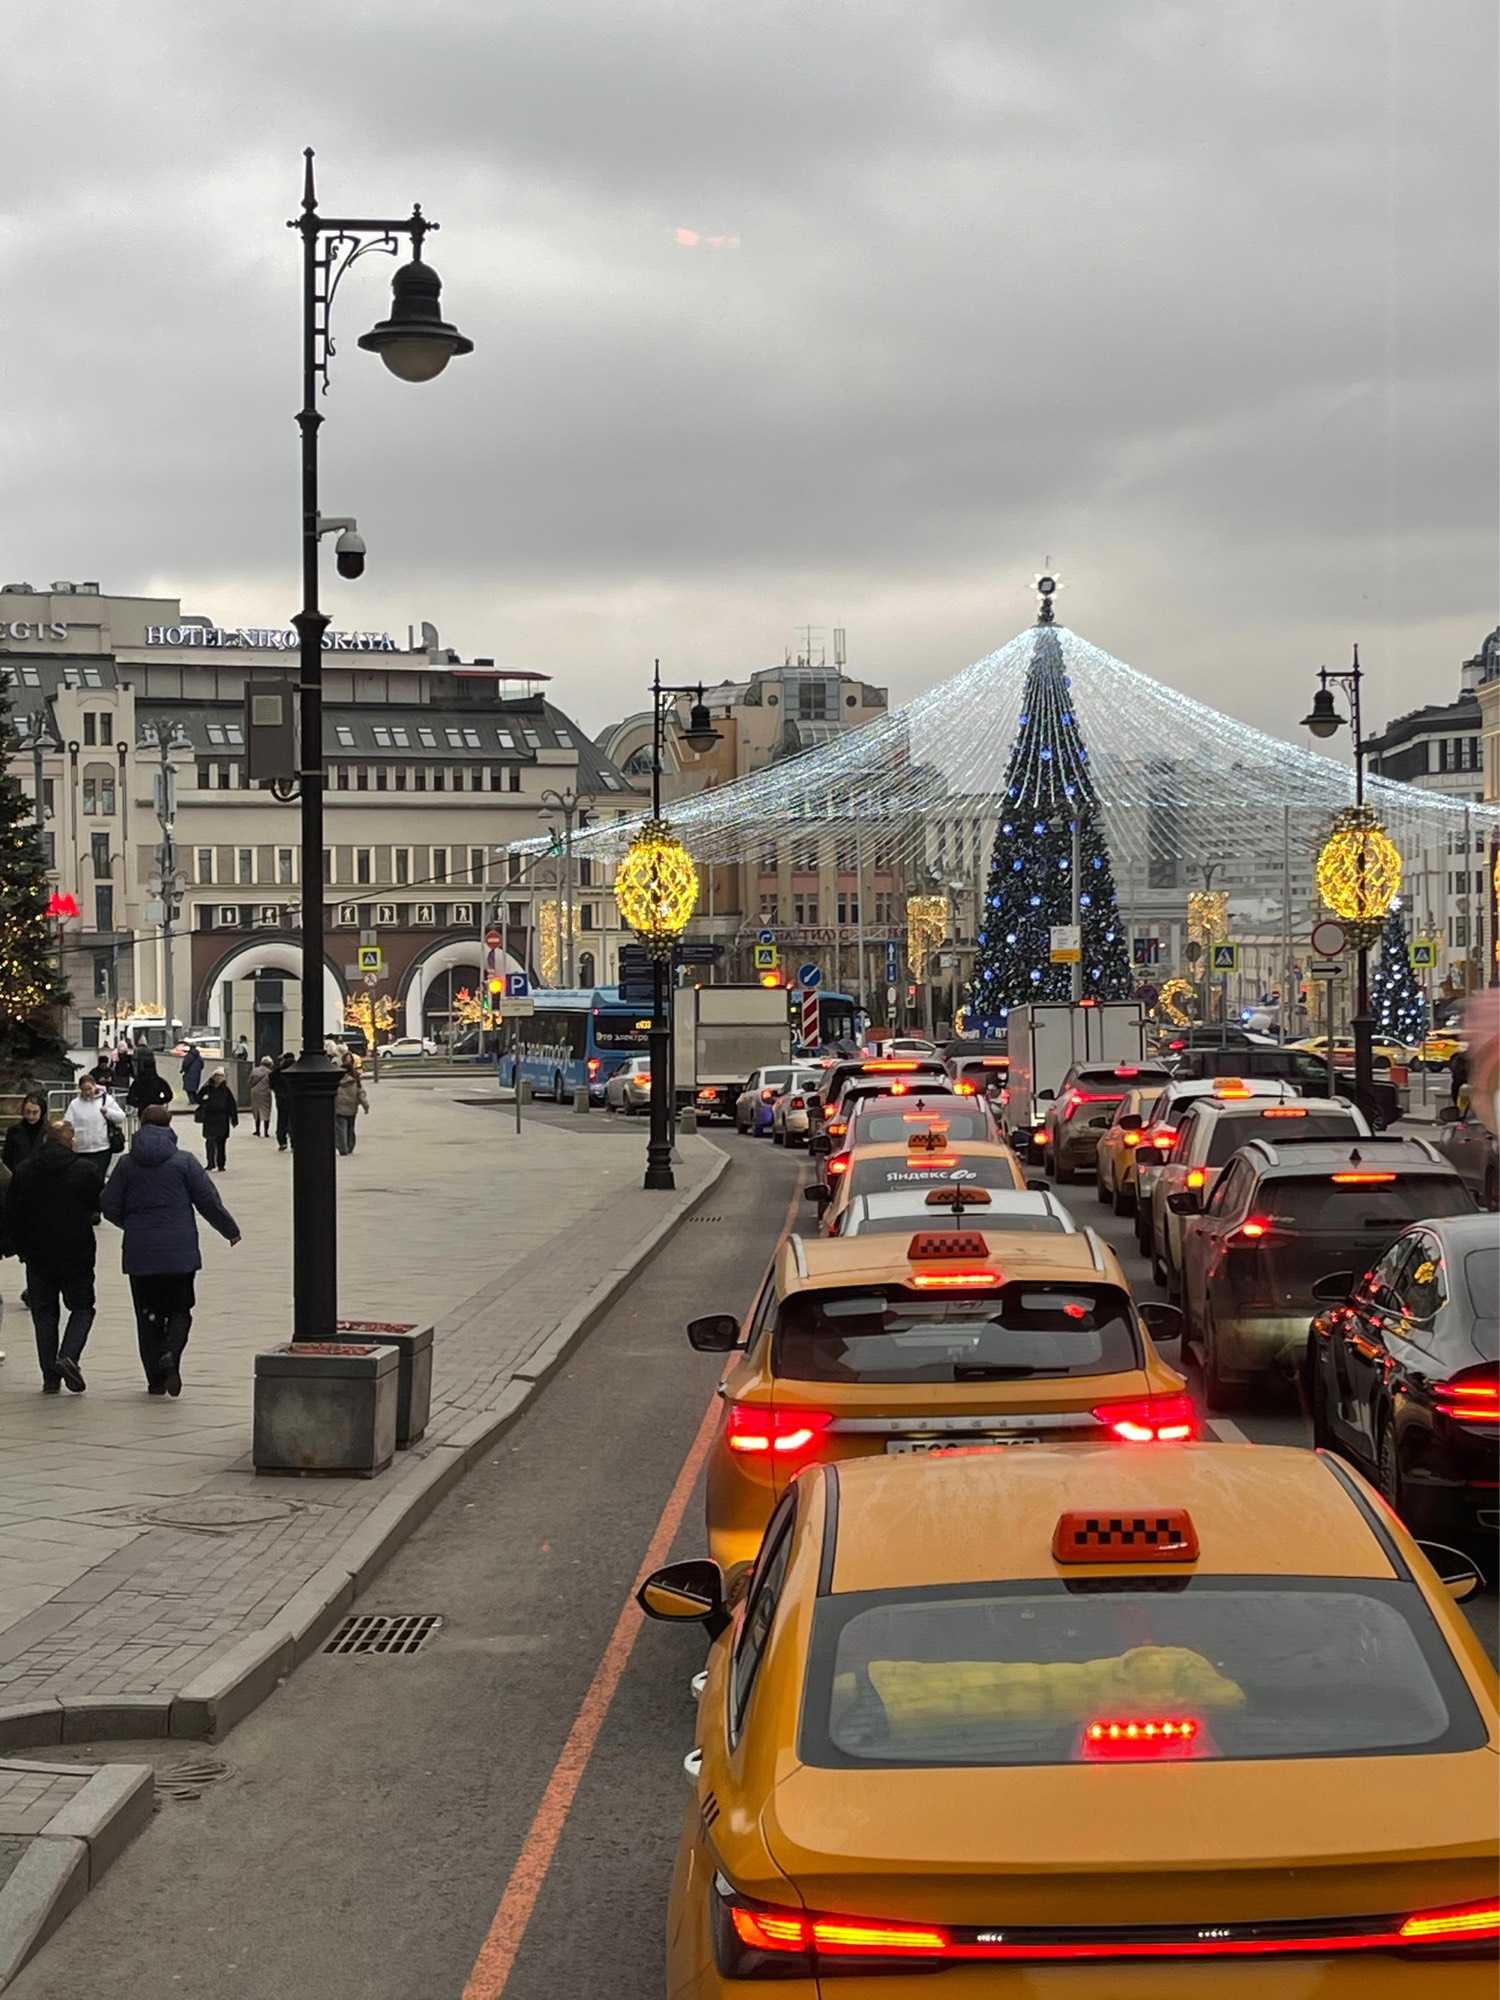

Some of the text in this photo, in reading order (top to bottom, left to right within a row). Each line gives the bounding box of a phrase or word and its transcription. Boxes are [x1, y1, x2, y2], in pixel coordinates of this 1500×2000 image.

[146, 626, 395, 651] HOTEL NIKOSKAYA
[511, 975, 524, 995] P
[886, 1172, 948, 1181] Яндекс
